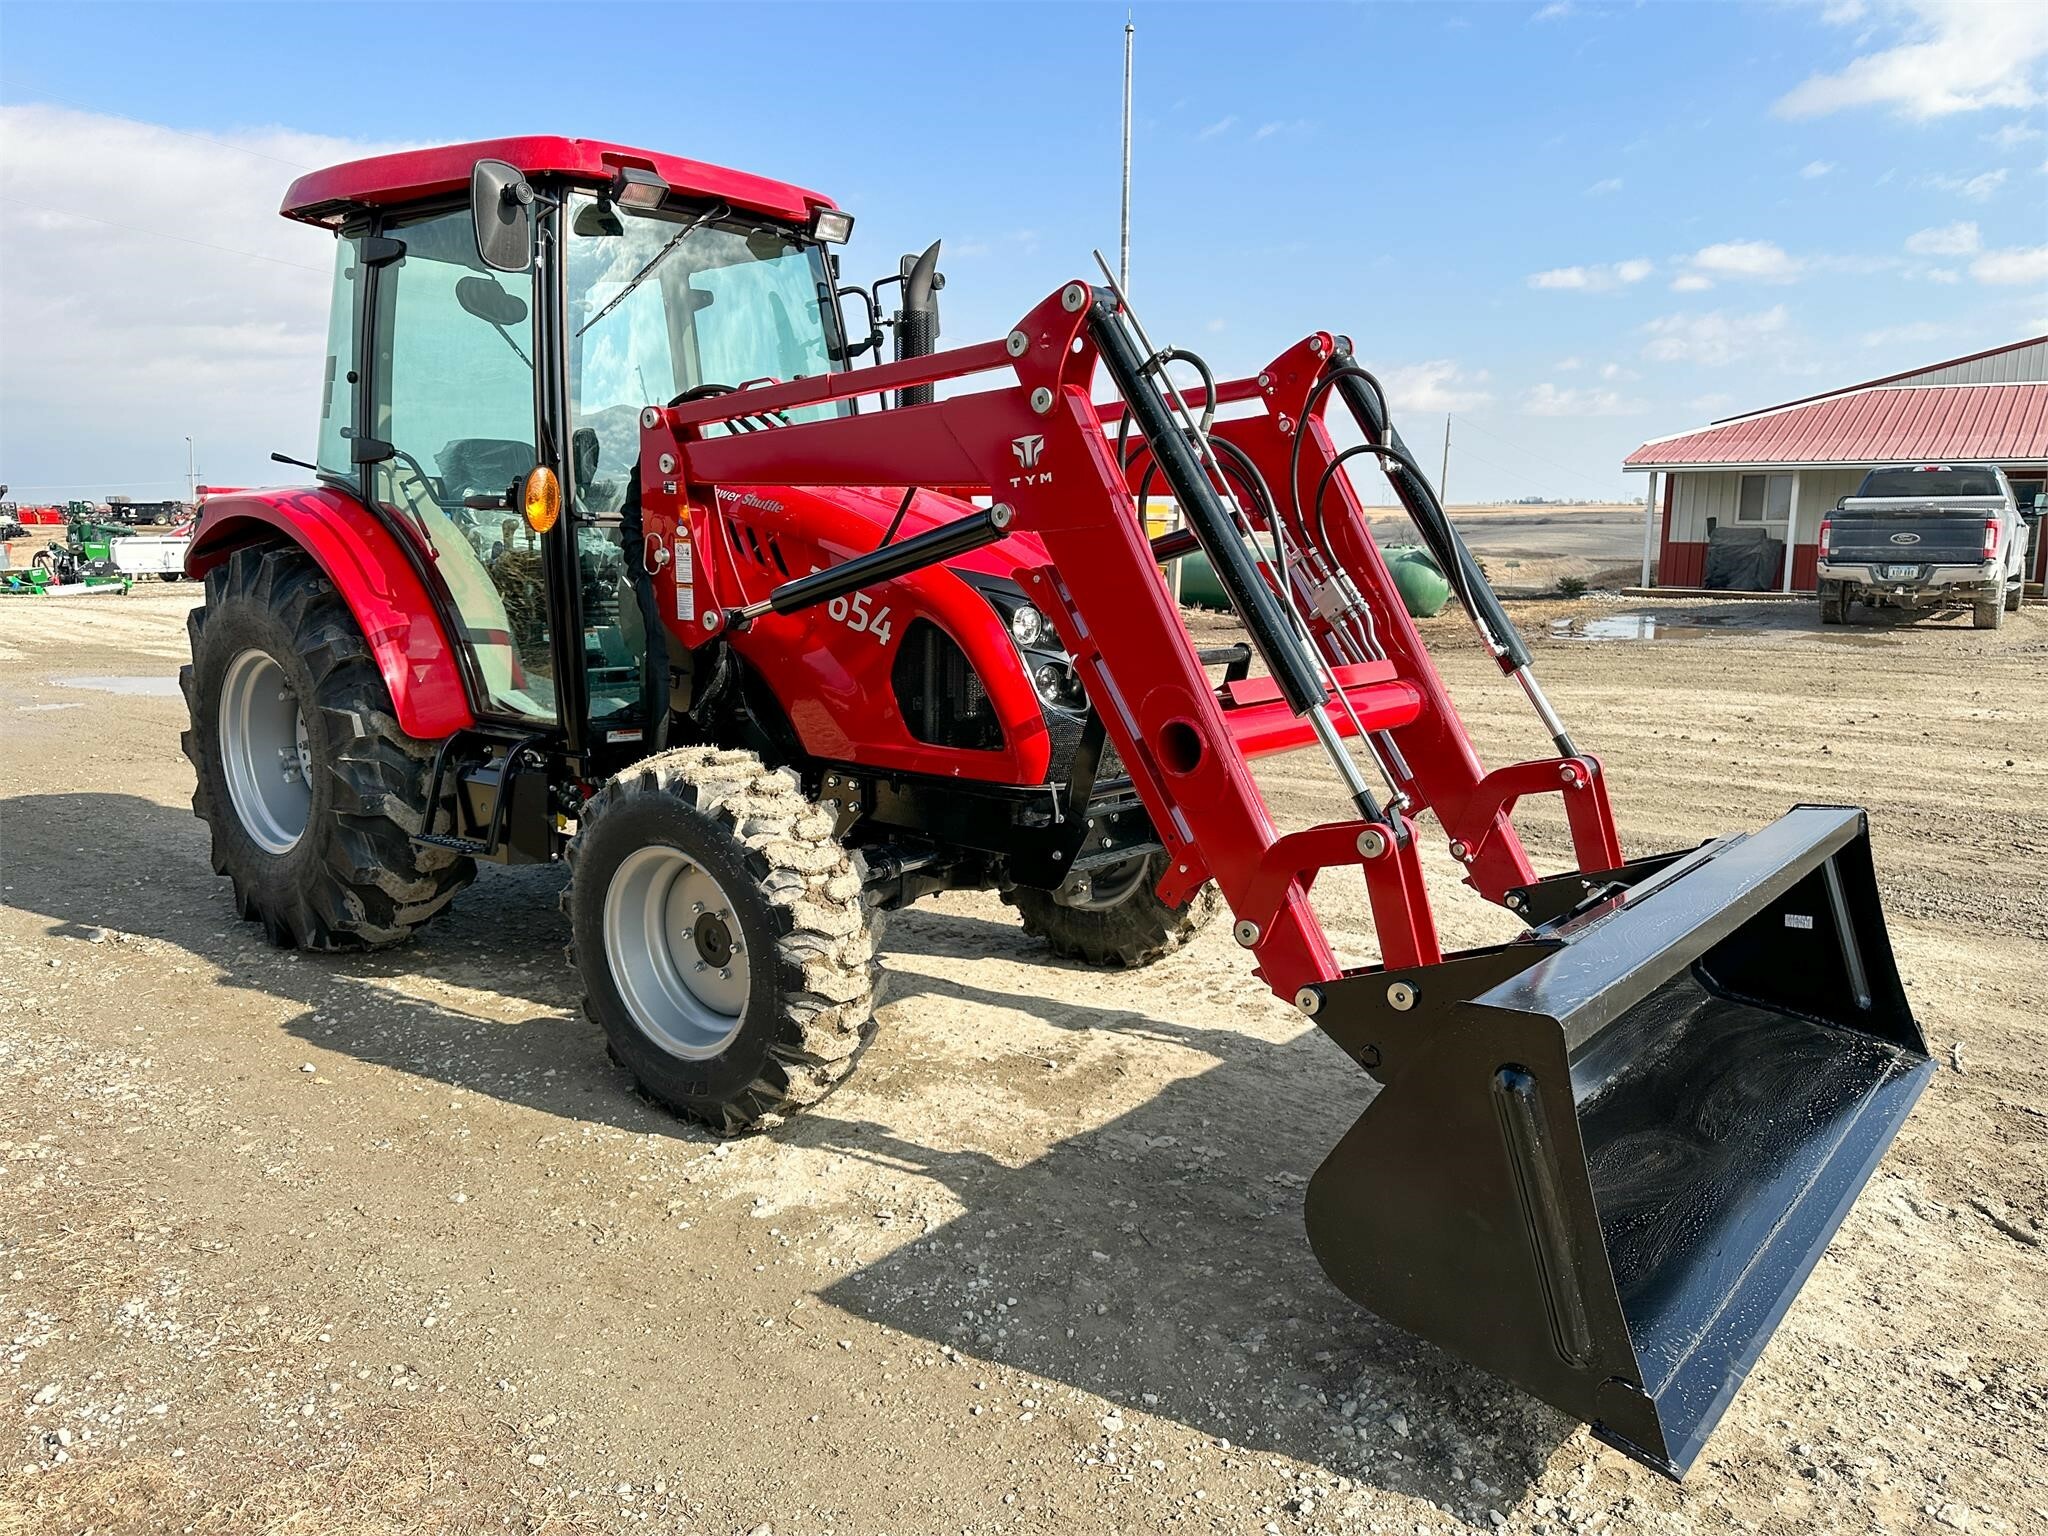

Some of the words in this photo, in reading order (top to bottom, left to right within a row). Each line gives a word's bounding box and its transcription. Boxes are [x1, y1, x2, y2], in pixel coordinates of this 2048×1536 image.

[1009, 472, 1052, 488] TYM
[715, 488, 741, 502] ower
[741, 493, 785, 513] Shuttle
[810, 565, 891, 646] 654
